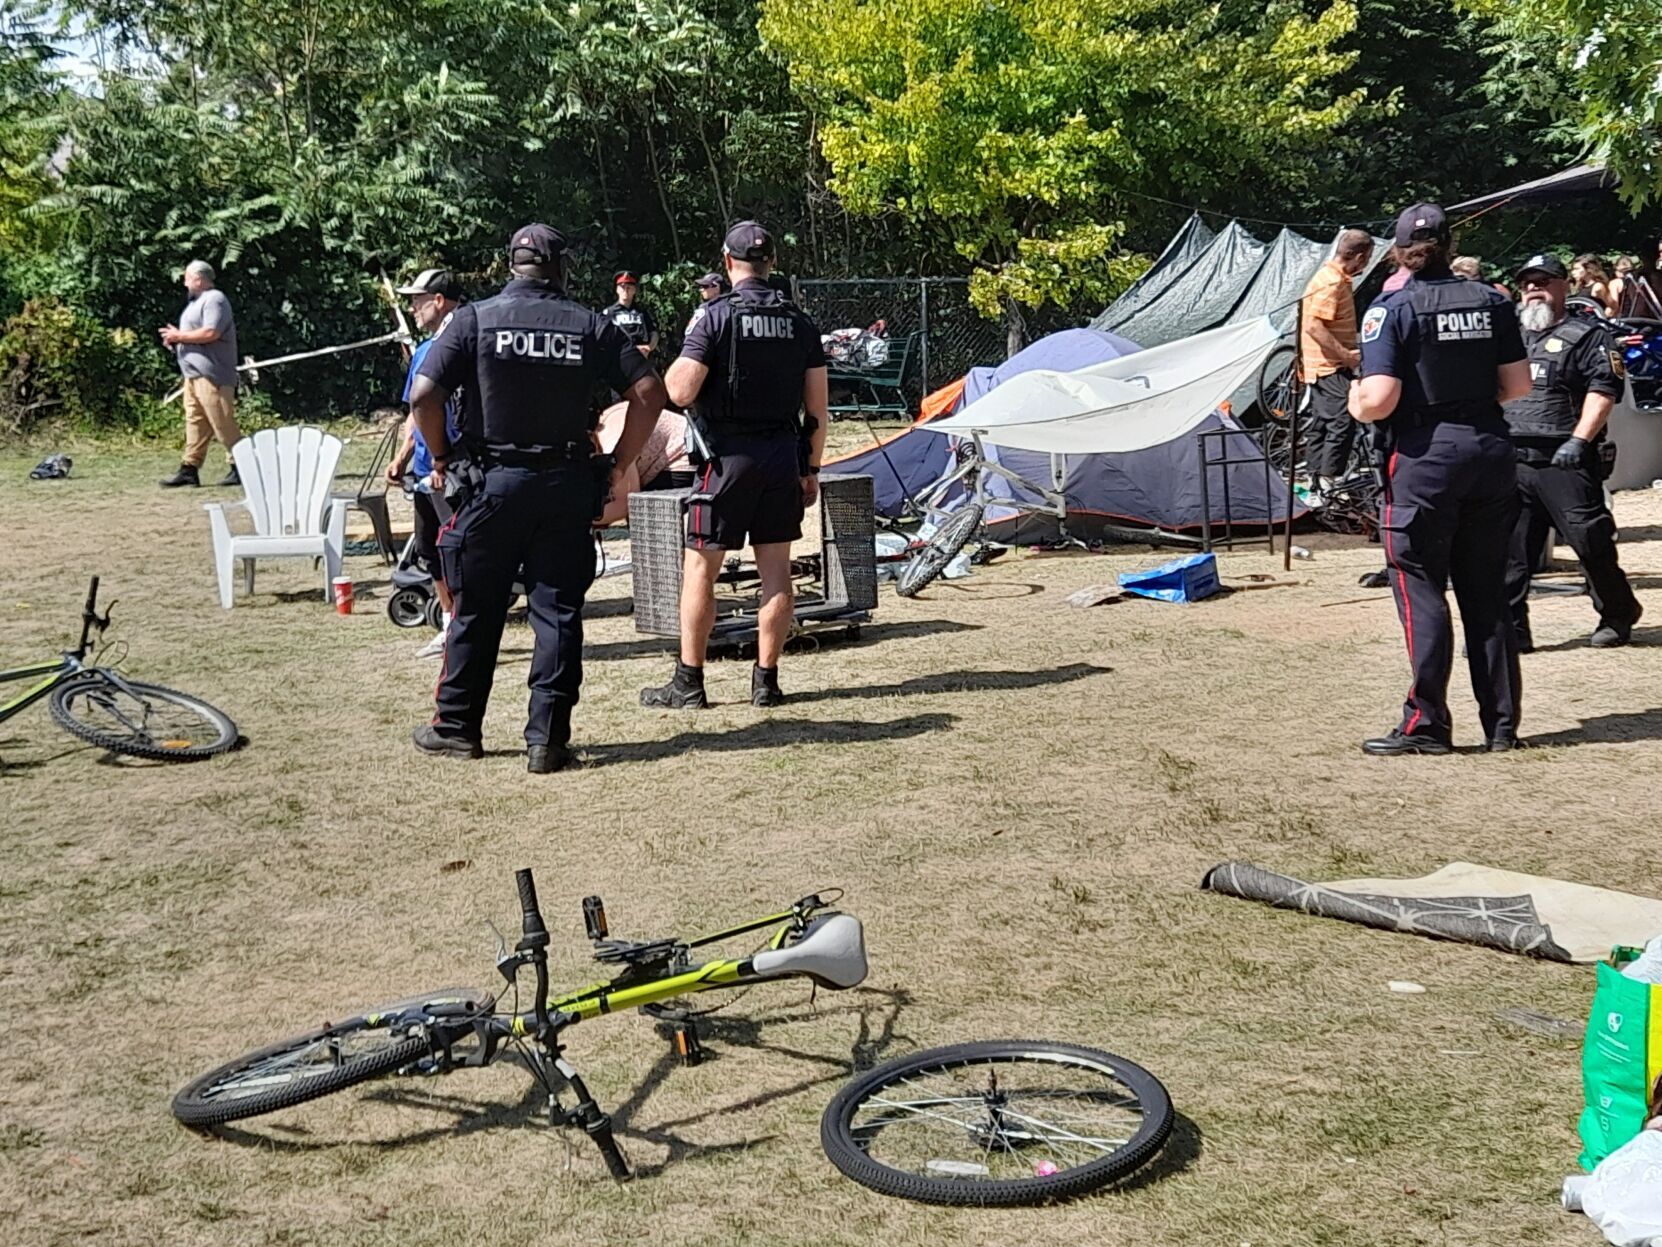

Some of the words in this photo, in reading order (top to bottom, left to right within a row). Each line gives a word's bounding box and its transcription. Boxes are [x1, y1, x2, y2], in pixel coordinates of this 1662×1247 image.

[741, 315, 795, 339] POLICE
[1436, 311, 1492, 332] POLICE
[496, 330, 583, 360] POLICE
